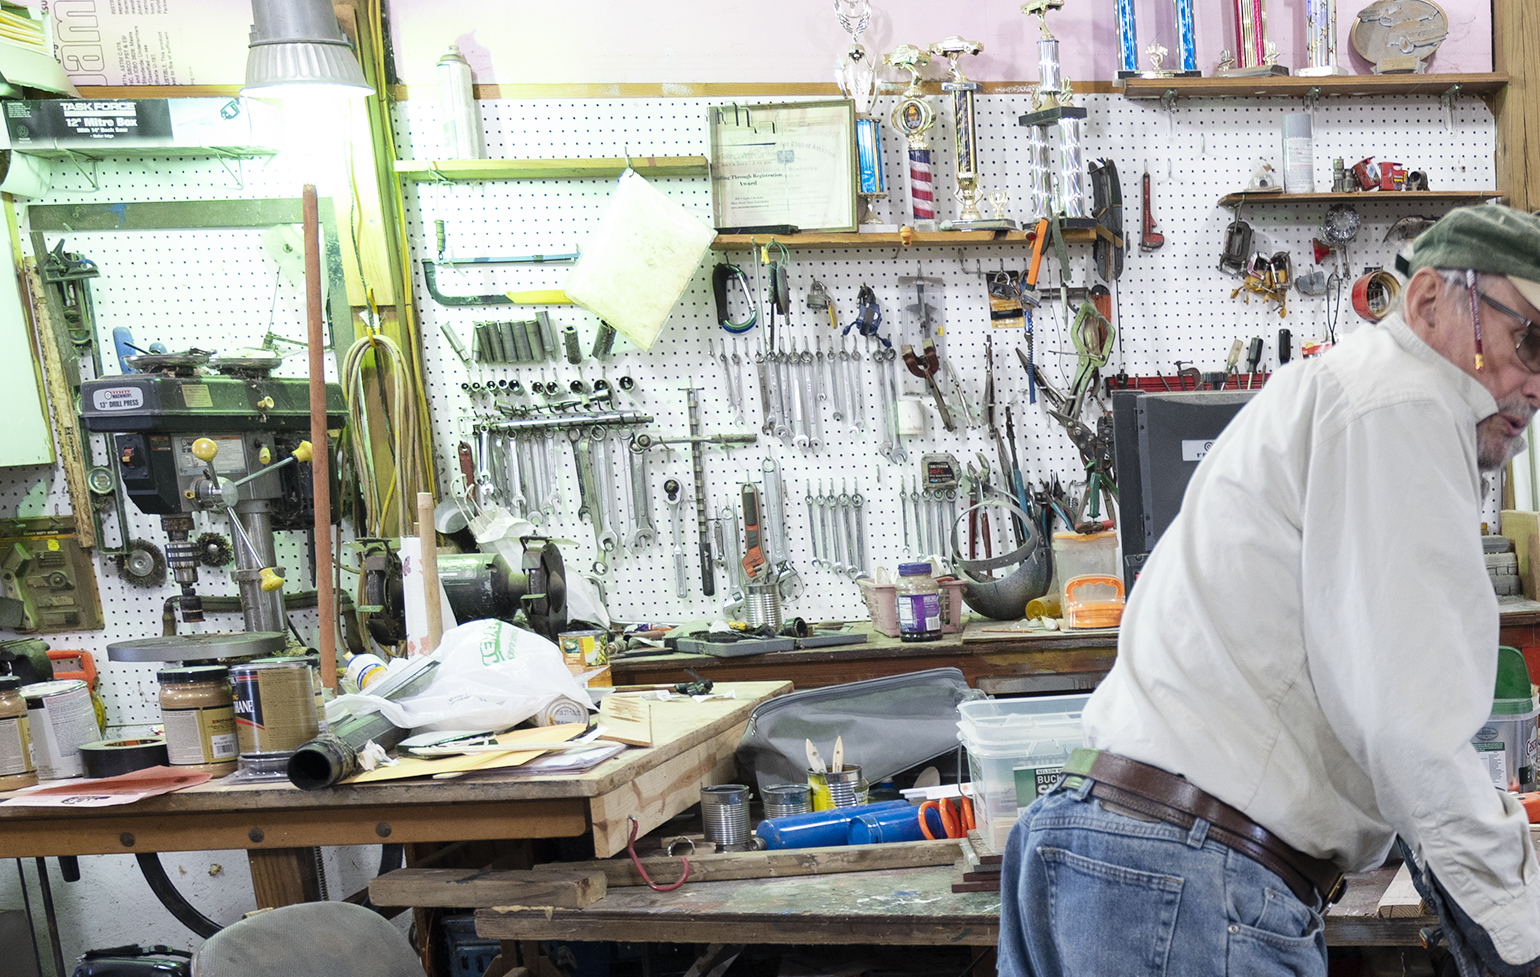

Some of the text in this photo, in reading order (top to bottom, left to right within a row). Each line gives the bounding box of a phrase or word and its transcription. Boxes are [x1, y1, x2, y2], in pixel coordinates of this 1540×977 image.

[60, 102, 137, 111] TASK FORCE
[84, 117, 114, 127] Mitre
[116, 117, 138, 127] Box
[109, 400, 123, 408] DRILL
[123, 399, 139, 407] PRESS
